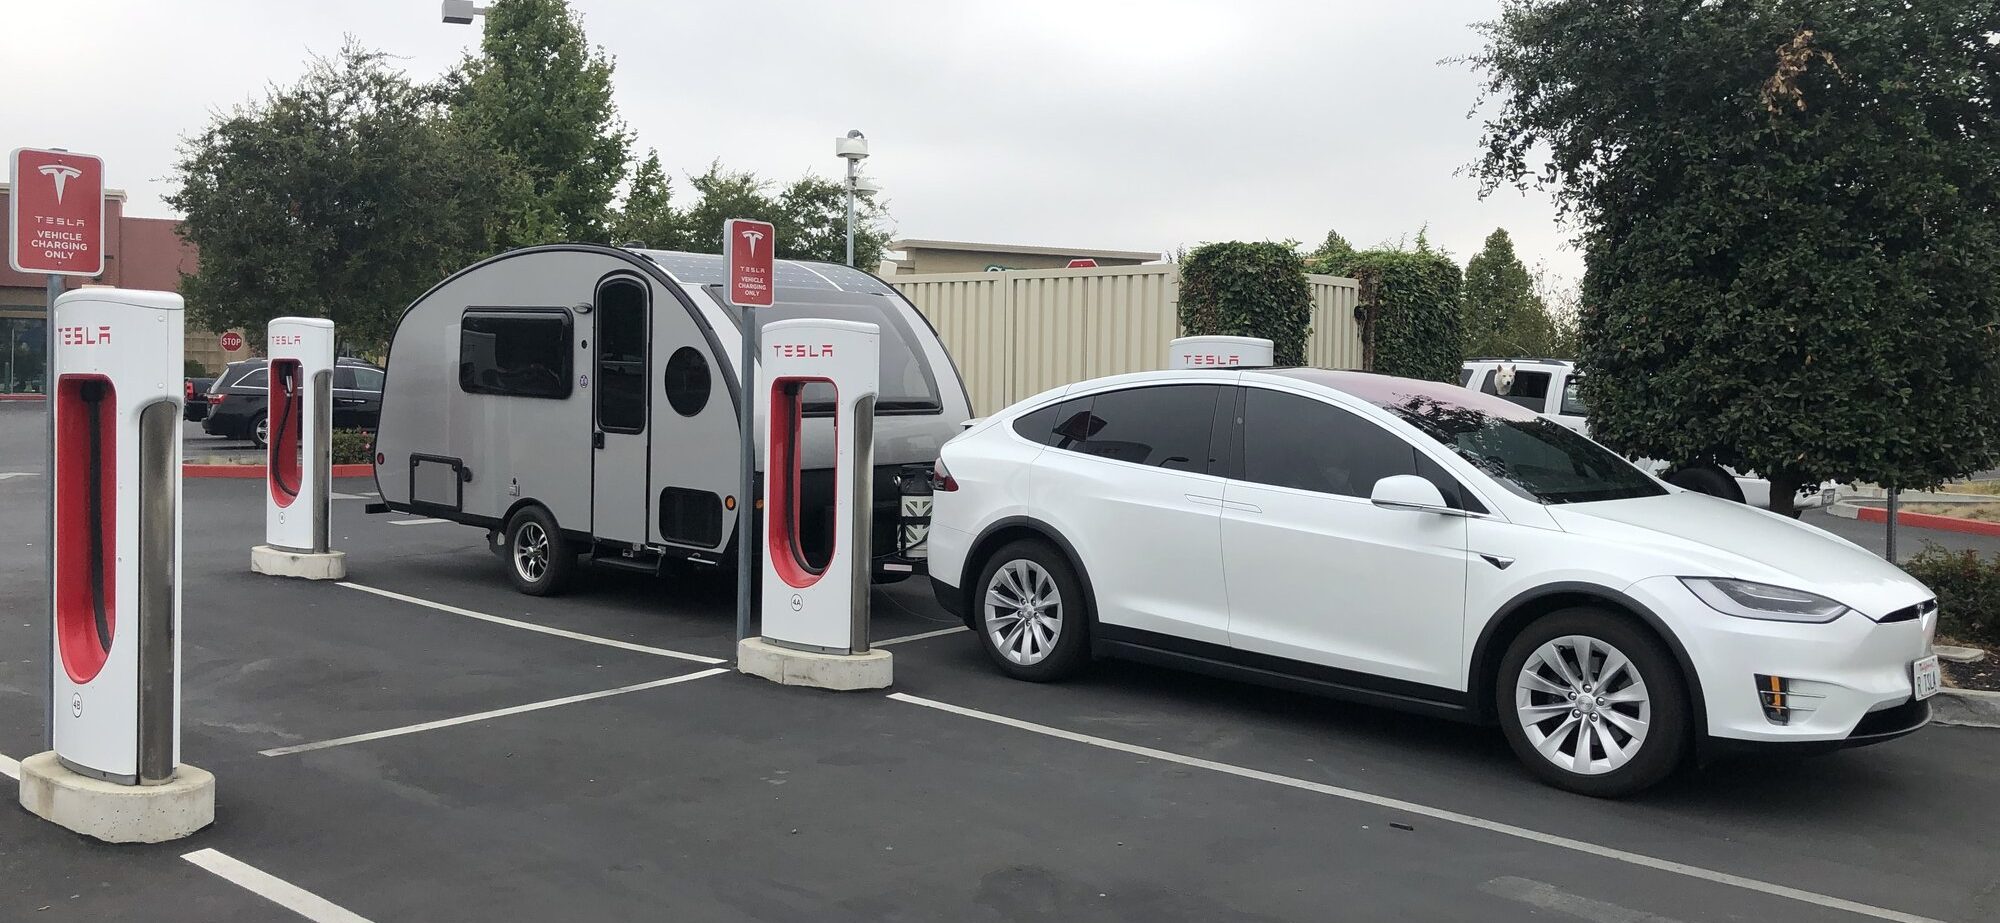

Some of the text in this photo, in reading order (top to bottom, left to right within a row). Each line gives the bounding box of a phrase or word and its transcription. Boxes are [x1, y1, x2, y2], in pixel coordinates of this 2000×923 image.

[35, 216, 85, 226] TESLA
[37, 230, 82, 241] VEHICLE
[31, 240, 88, 250] CHARGING
[44, 250, 74, 260] ONLY
[58, 326, 110, 345] TESLA
[272, 336, 300, 344] TESLA
[222, 336, 242, 346] STOP
[774, 344, 832, 358] TESLA
[1184, 355, 1238, 364] TESLA
